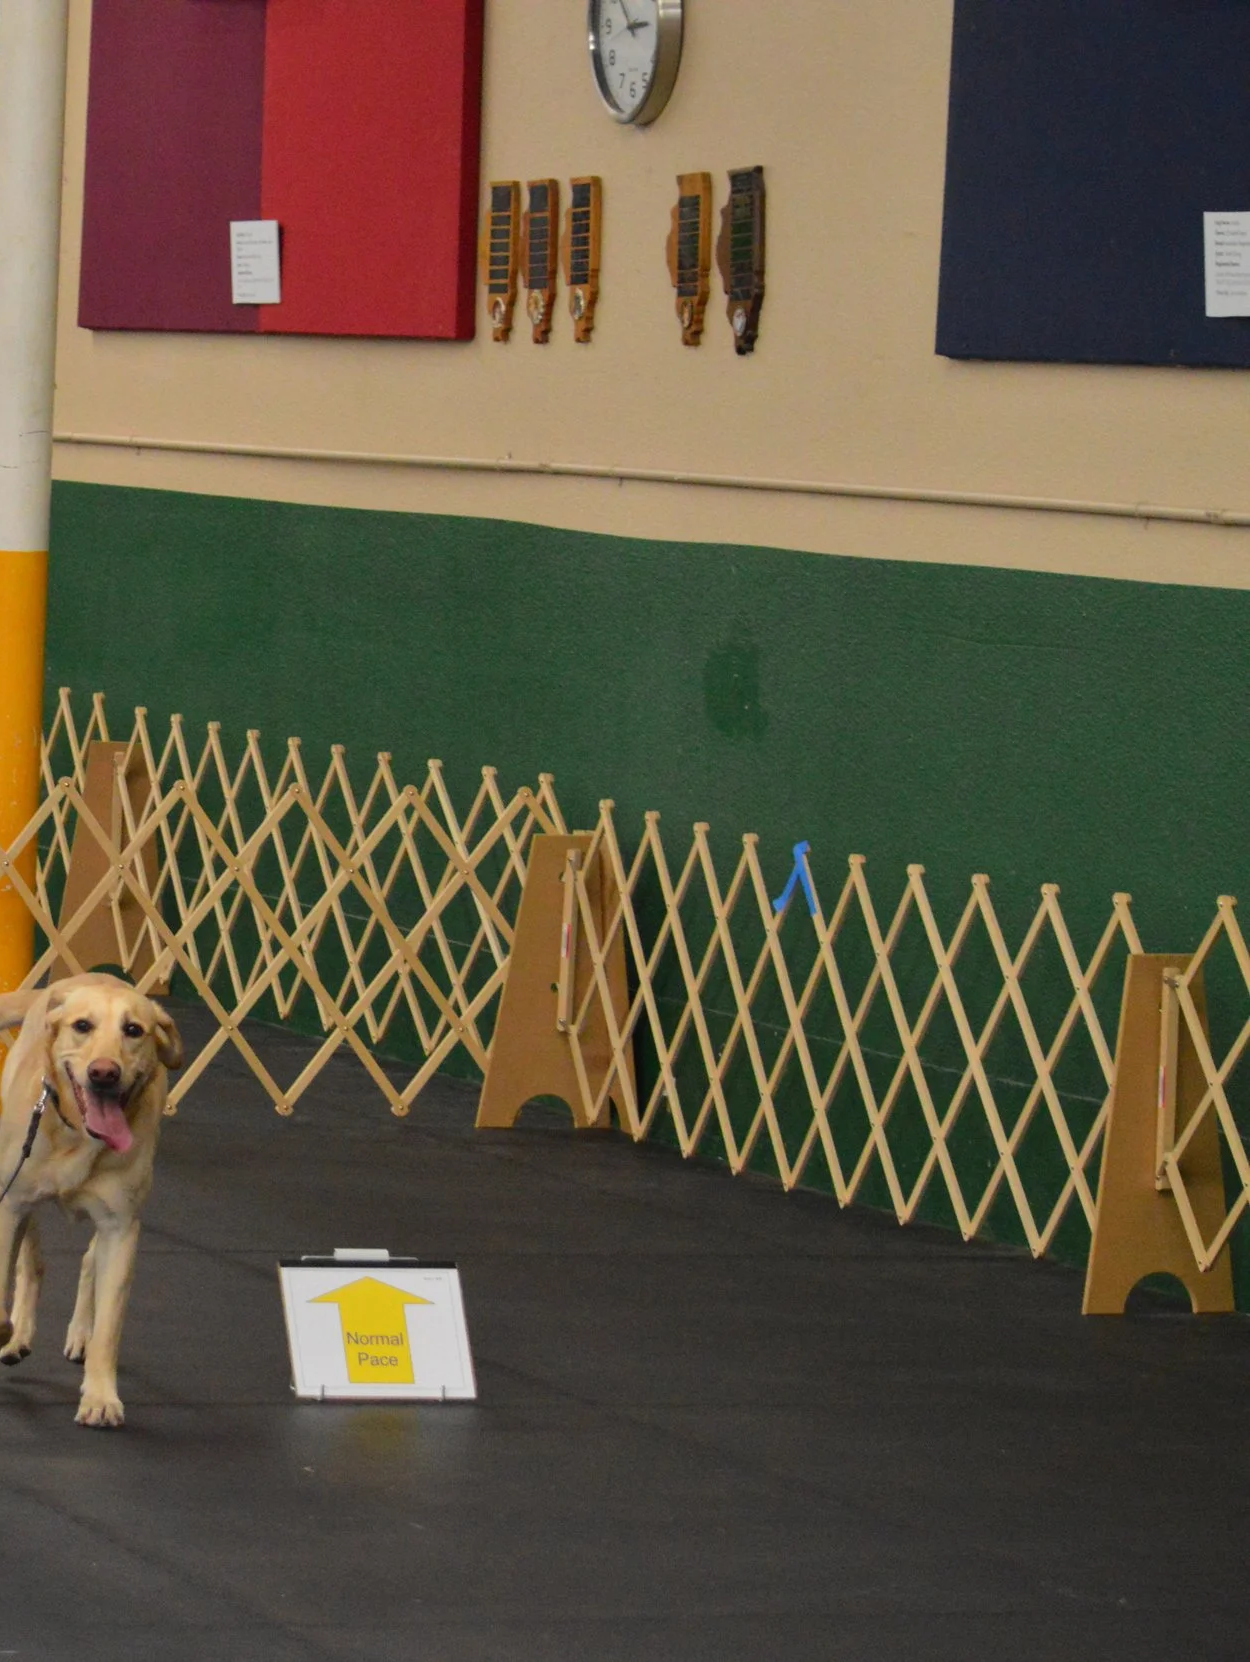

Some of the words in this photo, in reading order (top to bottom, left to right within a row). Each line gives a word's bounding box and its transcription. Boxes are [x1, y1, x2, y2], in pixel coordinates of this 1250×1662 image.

[609, 49, 616, 66] 8
[619, 72, 625, 88] 7
[629, 81, 636, 98] 6
[346, 1331, 404, 1346] Normal
[357, 1351, 399, 1366] Pace
